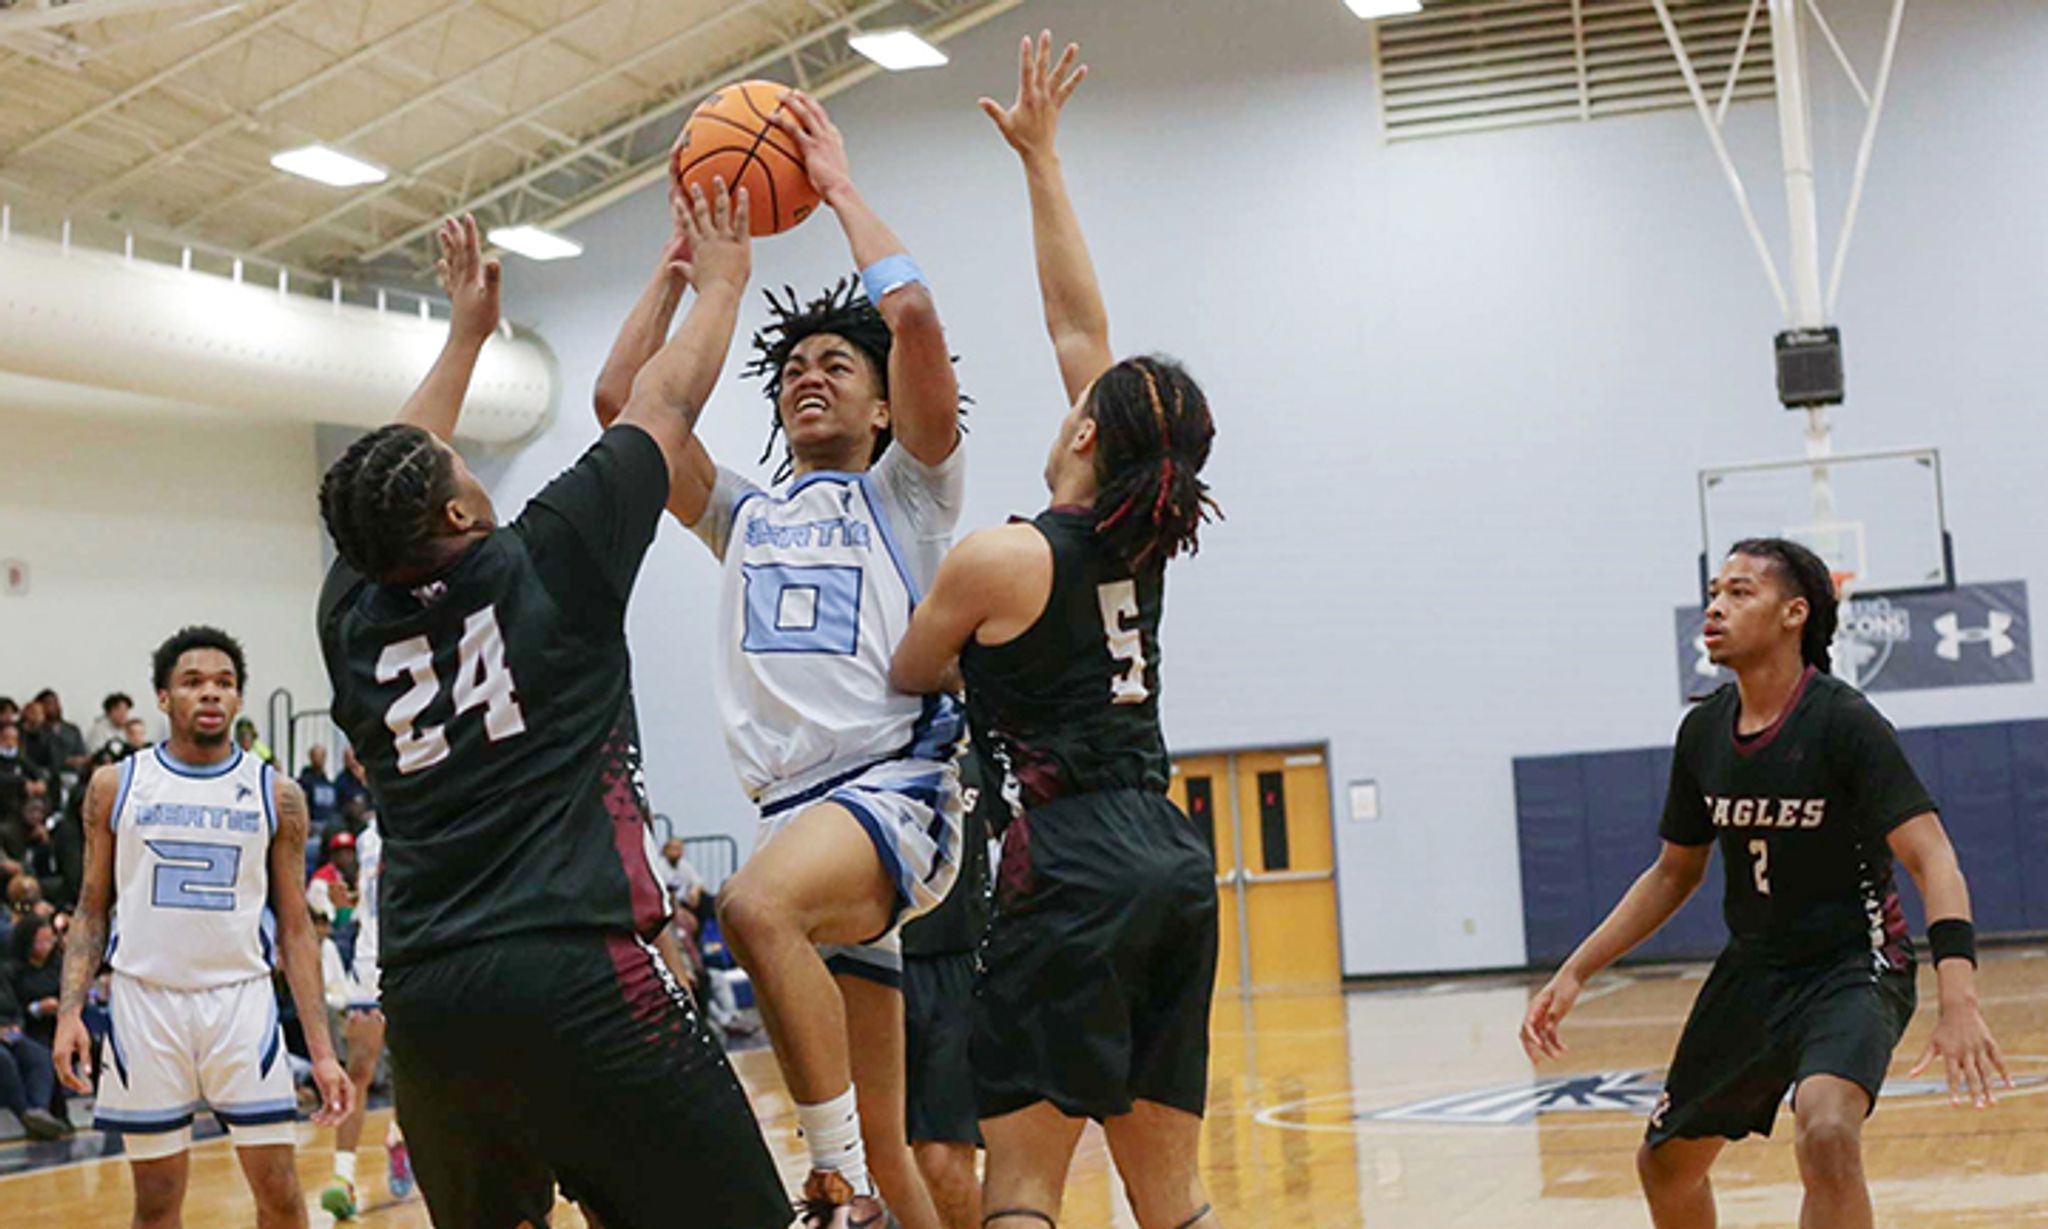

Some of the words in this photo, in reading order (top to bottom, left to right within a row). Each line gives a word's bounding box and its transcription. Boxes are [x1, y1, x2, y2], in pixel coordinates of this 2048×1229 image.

[741, 562, 863, 656] 0
[1097, 580, 1149, 704] 5
[375, 603, 527, 775] 24
[1704, 796, 1826, 826] AGLES
[143, 839, 242, 911] 2
[1748, 839, 1770, 895] 2
